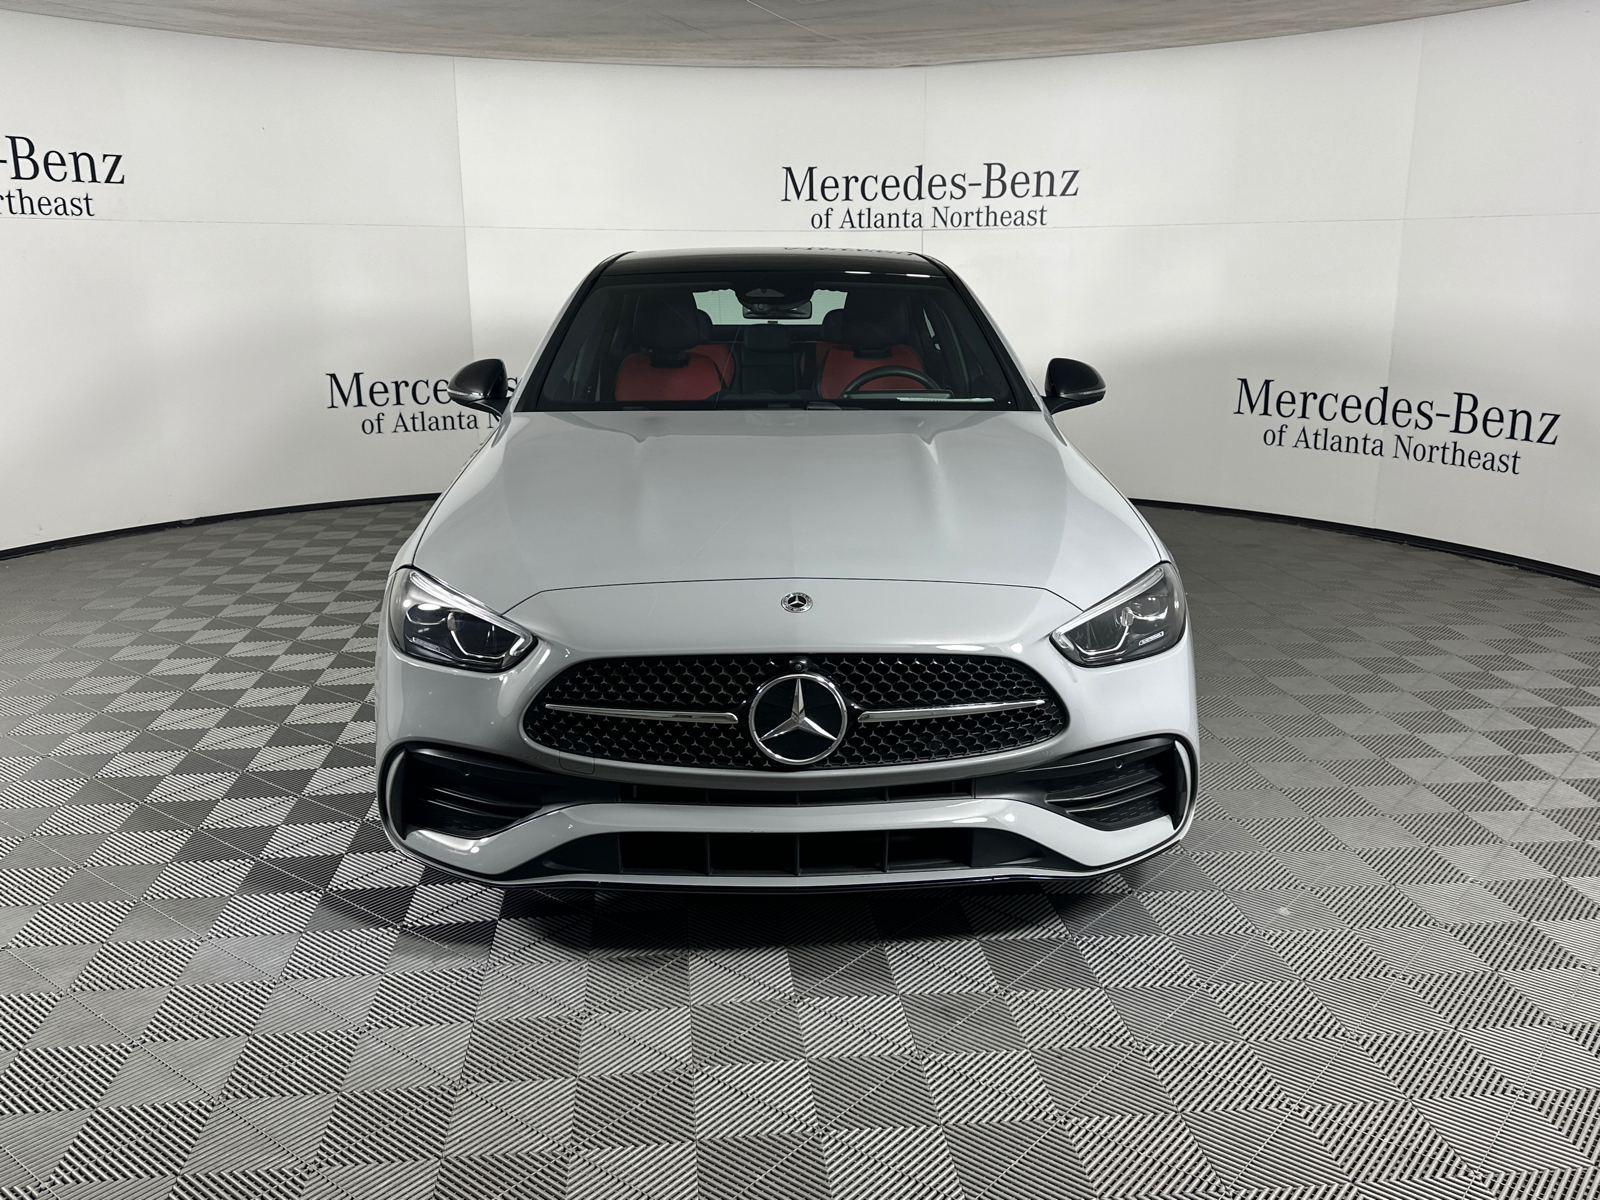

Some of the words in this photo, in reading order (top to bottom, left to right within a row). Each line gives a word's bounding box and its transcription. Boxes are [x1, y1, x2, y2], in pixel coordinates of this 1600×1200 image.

[781, 162, 1080, 202] Mercedes-Benz
[811, 207, 834, 229] of
[838, 207, 923, 229] Atlanta
[931, 205, 1048, 228] Northeast
[361, 412, 385, 435] of
[392, 411, 479, 434] Atlanta
[1233, 377, 1561, 446] Mercedes-Benz
[1263, 423, 1289, 447] of
[1292, 426, 1384, 457] Atlanta
[1392, 434, 1522, 475] Northeast
